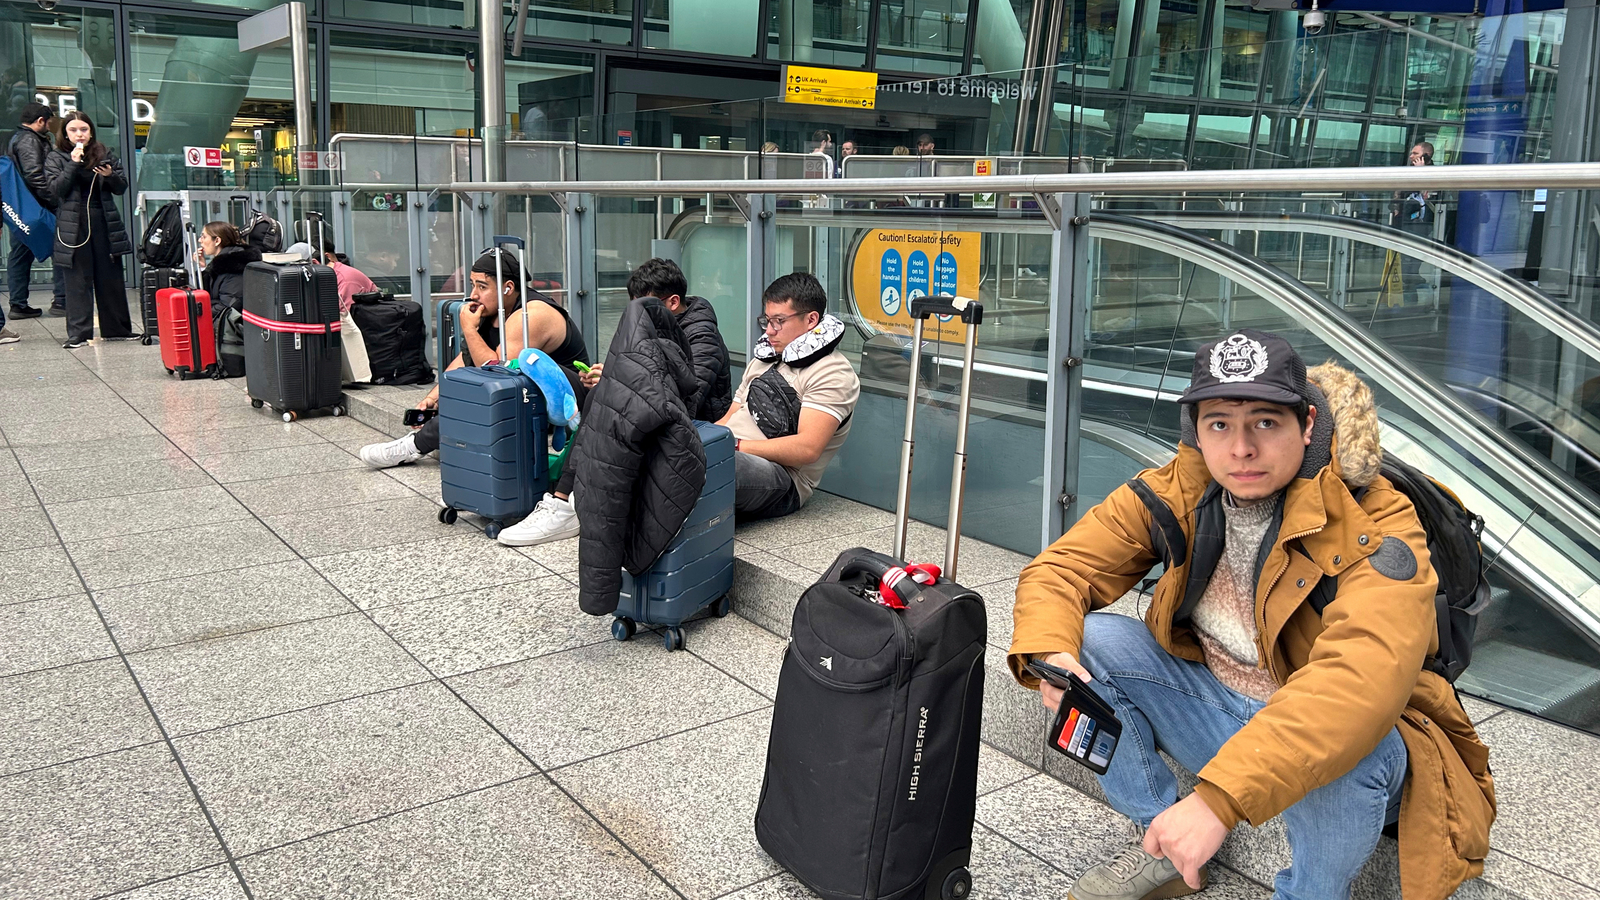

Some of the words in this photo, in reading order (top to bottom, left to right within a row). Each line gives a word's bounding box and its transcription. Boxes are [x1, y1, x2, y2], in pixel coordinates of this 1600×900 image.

[814, 96, 843, 104] International
[878, 232, 906, 243] Caution!
[907, 233, 938, 244] Escalator
[939, 233, 962, 247] safety
[908, 765, 920, 801] HIGH
